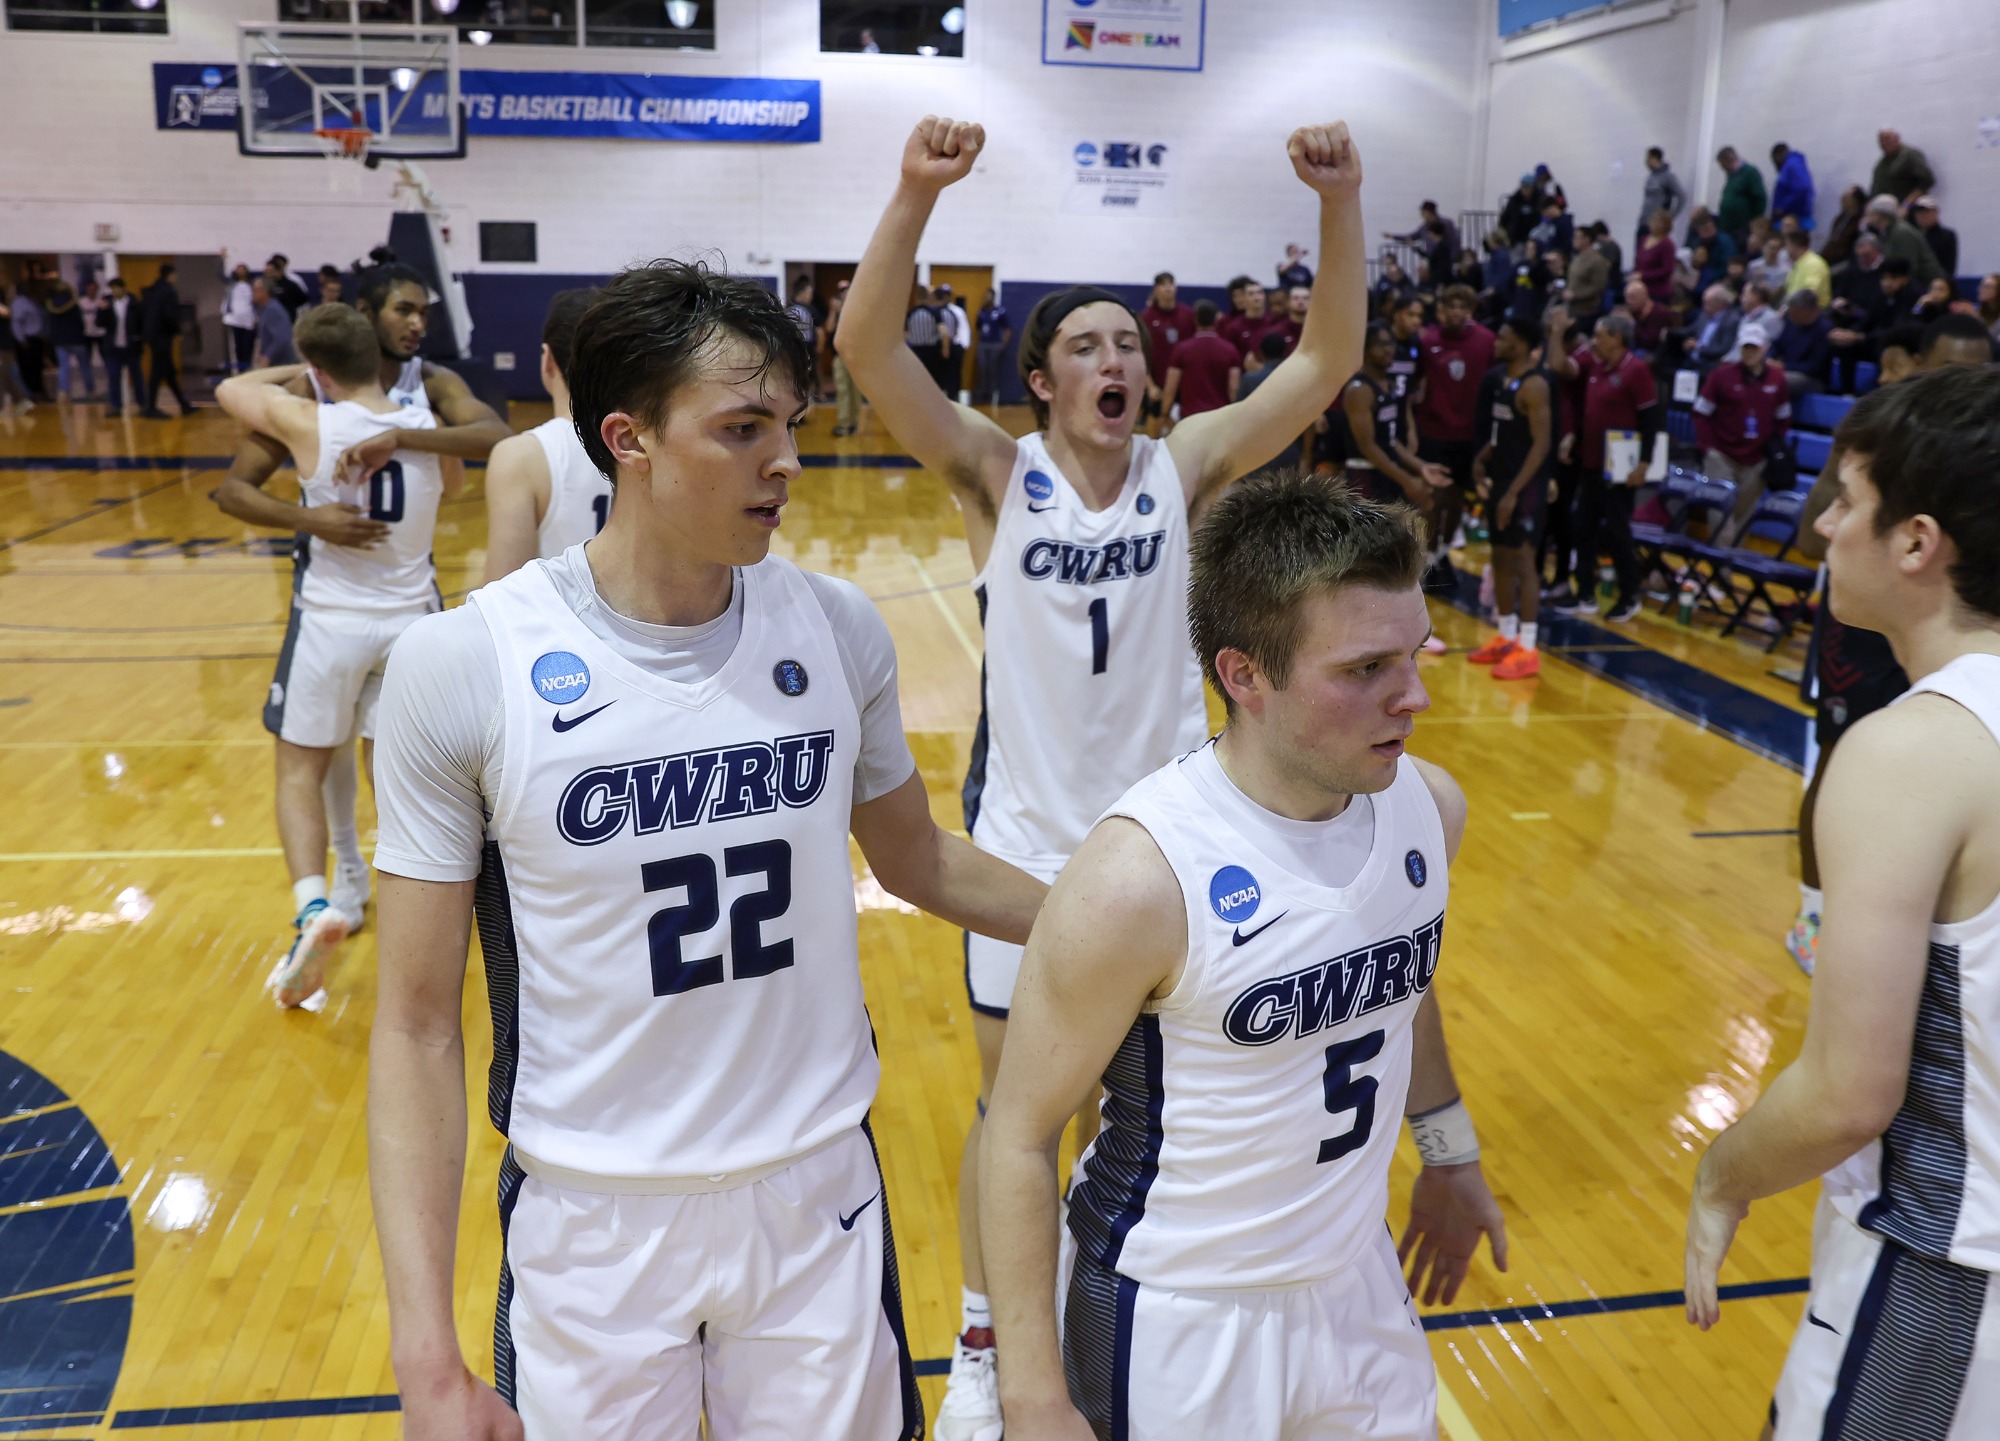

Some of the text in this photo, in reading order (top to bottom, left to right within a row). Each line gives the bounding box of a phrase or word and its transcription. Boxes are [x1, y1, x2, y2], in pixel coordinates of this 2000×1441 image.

[421, 92, 809, 127] MN'S BASKETBALL CHAMPIONSHIP
[1020, 530, 1166, 585] CWRU
[1088, 598, 1109, 675] 1
[541, 671, 587, 691] NCAA
[556, 729, 835, 847] CWRU
[641, 838, 795, 998] 22
[1219, 885, 1259, 913] NCAA
[1222, 909, 1445, 1047] CWRU
[1316, 1029, 1385, 1165] 5
